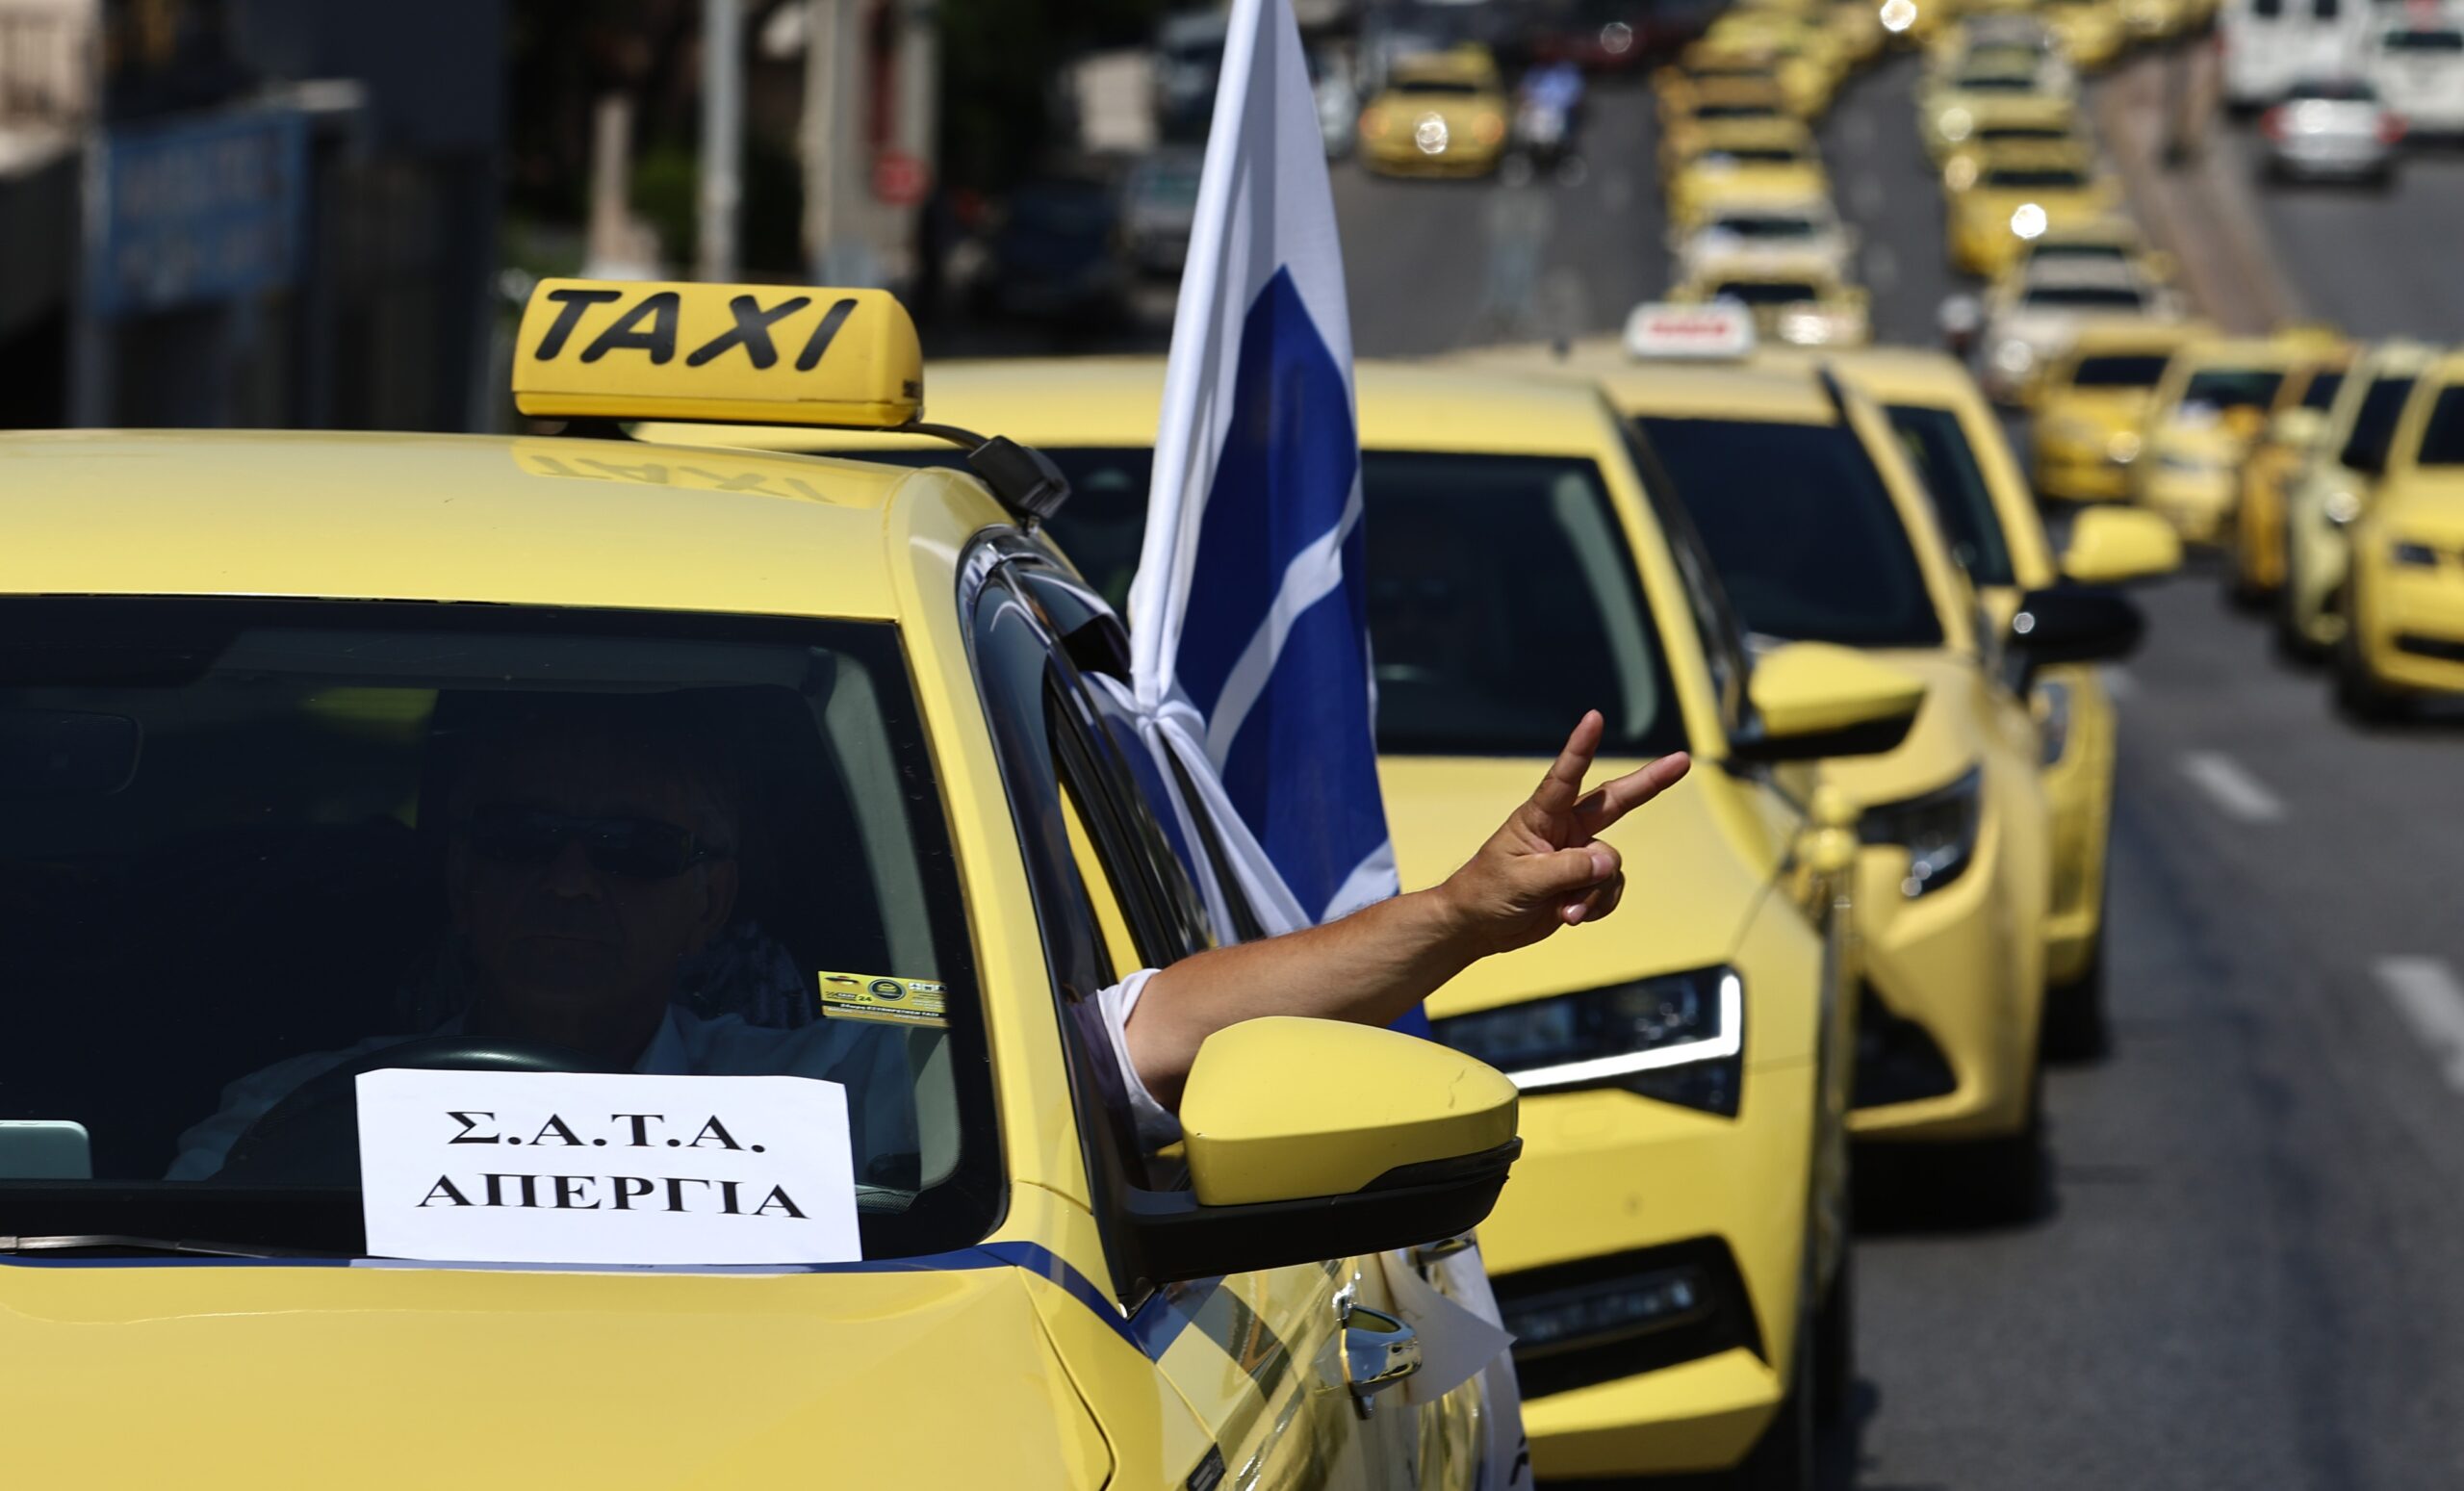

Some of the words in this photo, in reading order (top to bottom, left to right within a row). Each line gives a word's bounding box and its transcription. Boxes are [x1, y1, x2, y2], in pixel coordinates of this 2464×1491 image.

[535, 289, 859, 372] TAXI
[446, 1111, 766, 1153] Σ.Α.Τ.Α.
[415, 1173, 811, 1219] ΑΠΕΡΓΙΑ
